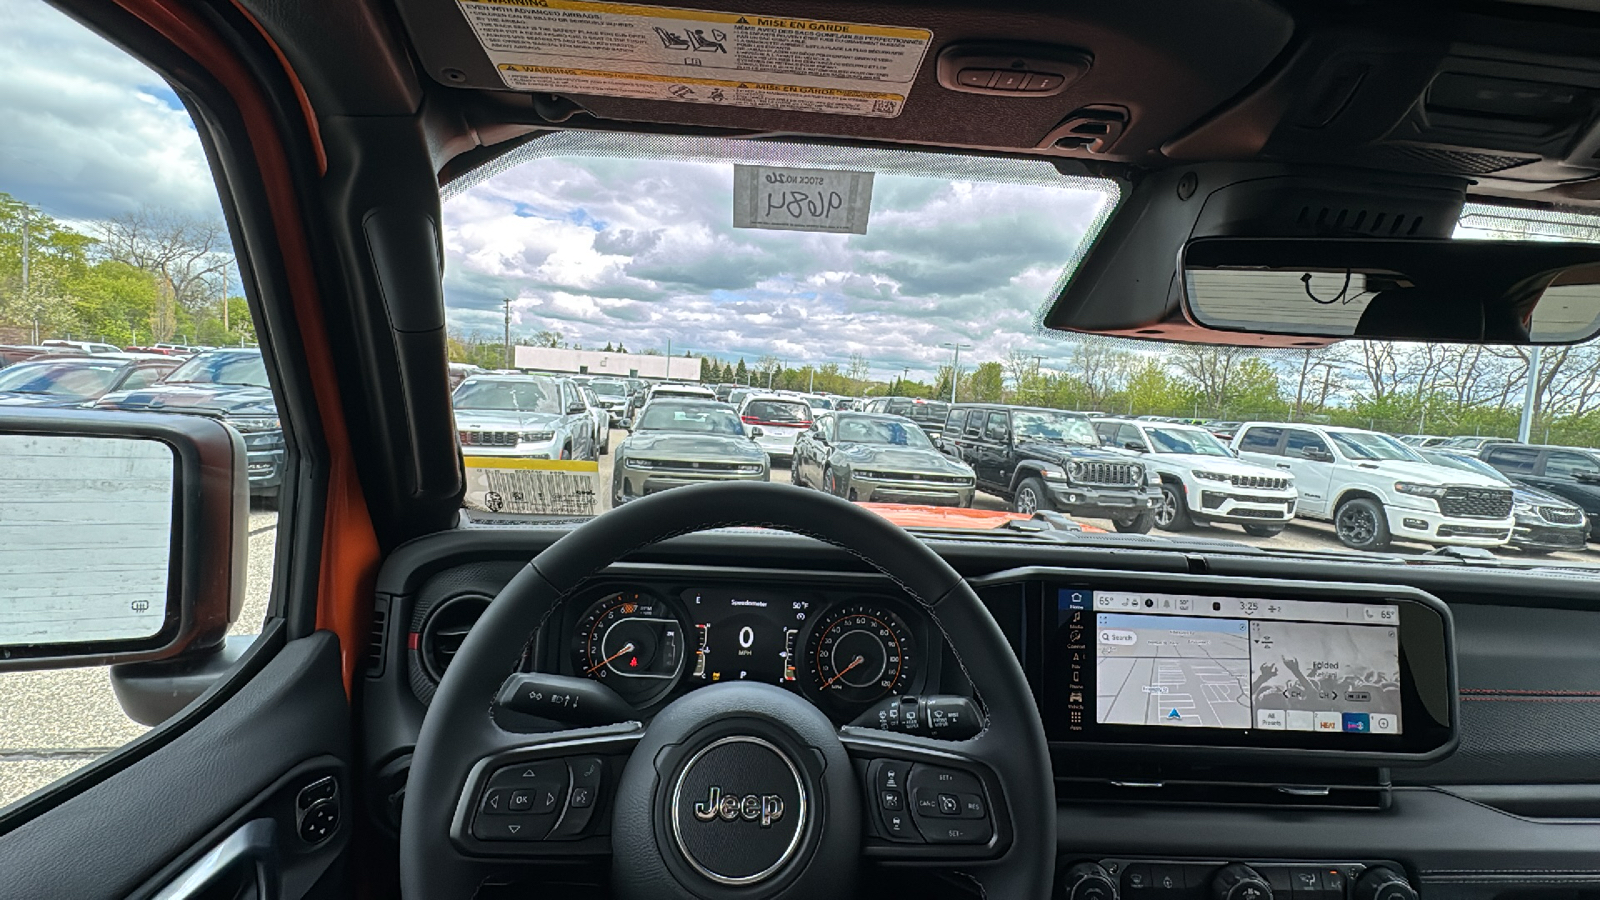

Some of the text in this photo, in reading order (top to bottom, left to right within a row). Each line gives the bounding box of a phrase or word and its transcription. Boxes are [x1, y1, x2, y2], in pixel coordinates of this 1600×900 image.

[757, 18, 850, 33] MISE EN GARDE
[799, 88, 834, 96] GARDE
[731, 599, 767, 608] Speedometer
[1099, 596, 1114, 605] 65°
[633, 604, 639, 612] 7
[1240, 601, 1258, 610] 3:25
[1381, 610, 1395, 619] 65°
[831, 626, 841, 634] 40
[592, 633, 598, 641] 3
[738, 626, 754, 648] 0
[591, 646, 597, 654] 2
[1312, 661, 1339, 669] Folded
[600, 670, 607, 678] 0
[740, 671, 747, 679] P
[516, 795, 528, 803] OK
[694, 786, 785, 826] Jeep
